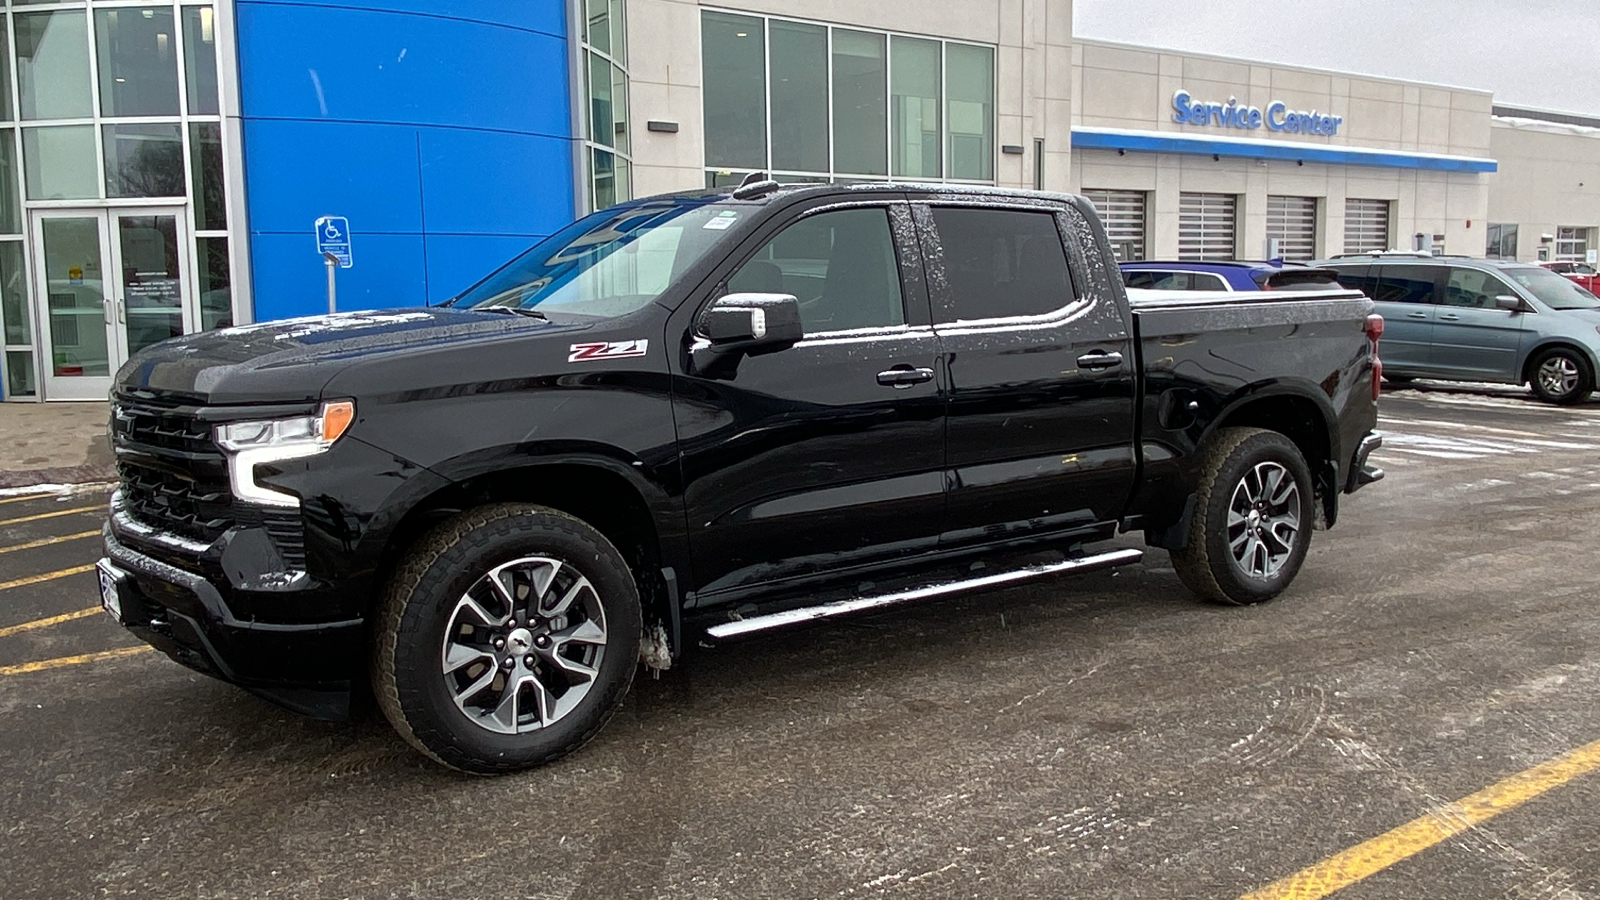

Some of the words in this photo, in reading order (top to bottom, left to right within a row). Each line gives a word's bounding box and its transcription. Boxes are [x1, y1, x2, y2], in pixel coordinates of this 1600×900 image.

[1172, 89, 1261, 129] Service
[1265, 100, 1342, 136] Center
[568, 339, 648, 362] Z71
